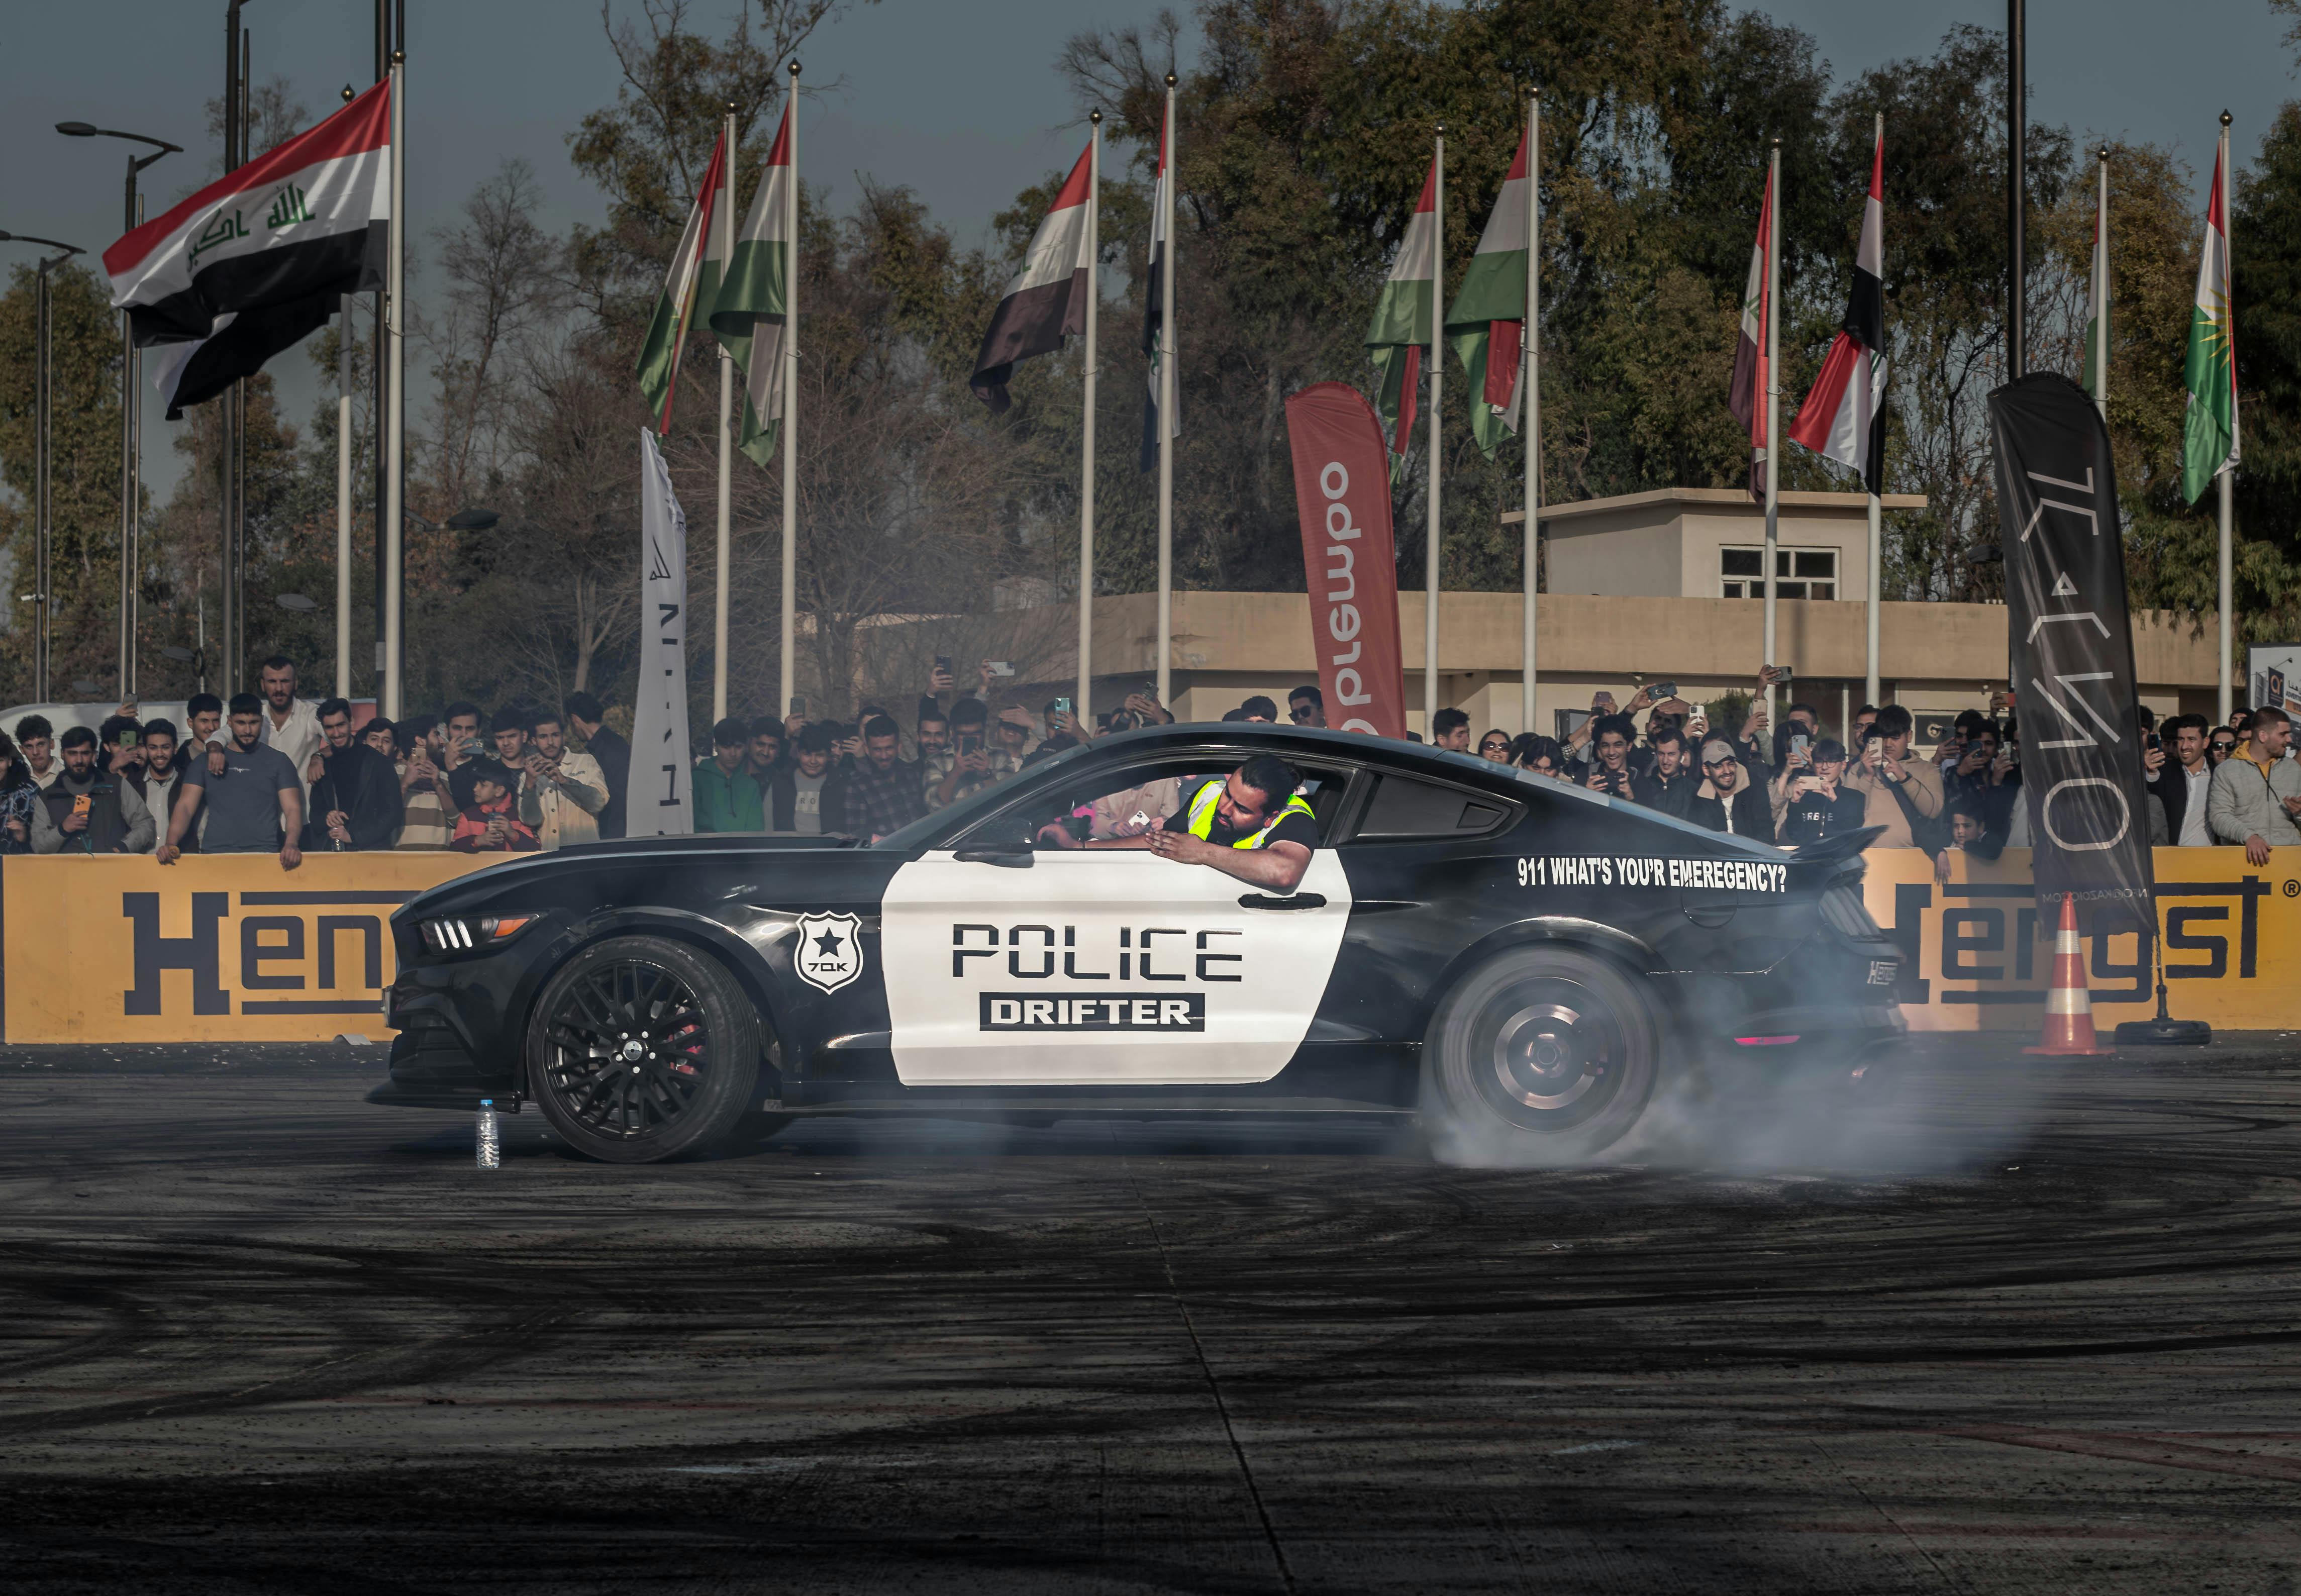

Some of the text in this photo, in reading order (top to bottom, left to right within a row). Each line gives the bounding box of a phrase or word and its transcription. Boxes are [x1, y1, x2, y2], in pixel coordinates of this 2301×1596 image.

[1518, 857, 1786, 893] 911 WHAT'S YOU'R EMEREGENCY?
[953, 924, 1243, 982] POLICE
[990, 999, 1192, 1026] DRIFTER
